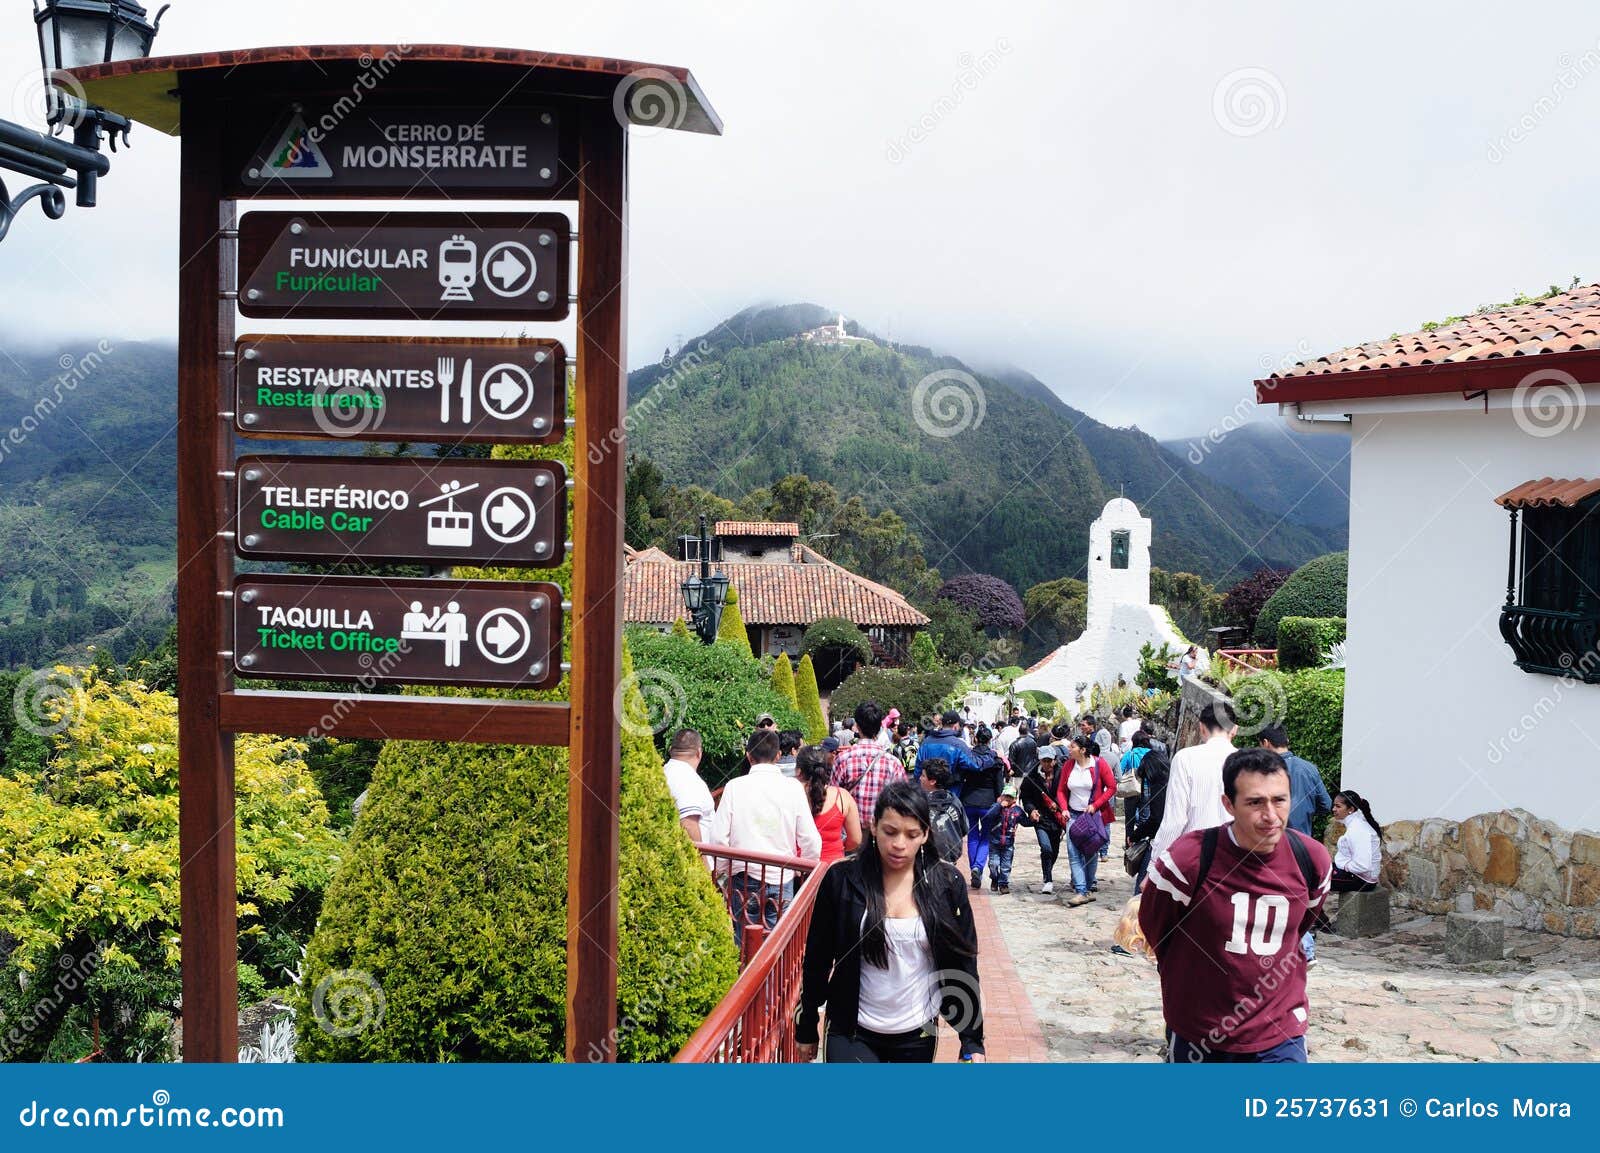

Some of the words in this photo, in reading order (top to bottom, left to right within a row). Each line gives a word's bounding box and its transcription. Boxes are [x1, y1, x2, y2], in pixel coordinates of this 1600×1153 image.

[384, 125, 451, 141] CERRO
[458, 125, 485, 141] DE
[342, 145, 527, 168] MONSERRATE
[290, 247, 428, 269] FUNICULAR
[275, 272, 382, 292] Funicular
[257, 367, 435, 389] RESTAURANTES
[257, 388, 383, 409] Restaurants
[260, 484, 409, 510] TELEFÉRICO
[260, 509, 325, 530] Cable
[331, 511, 373, 532] Car
[257, 606, 374, 630] TAQUILLA
[257, 628, 325, 650] Ticket
[330, 631, 400, 653] Office
[1224, 891, 1290, 955] 10
